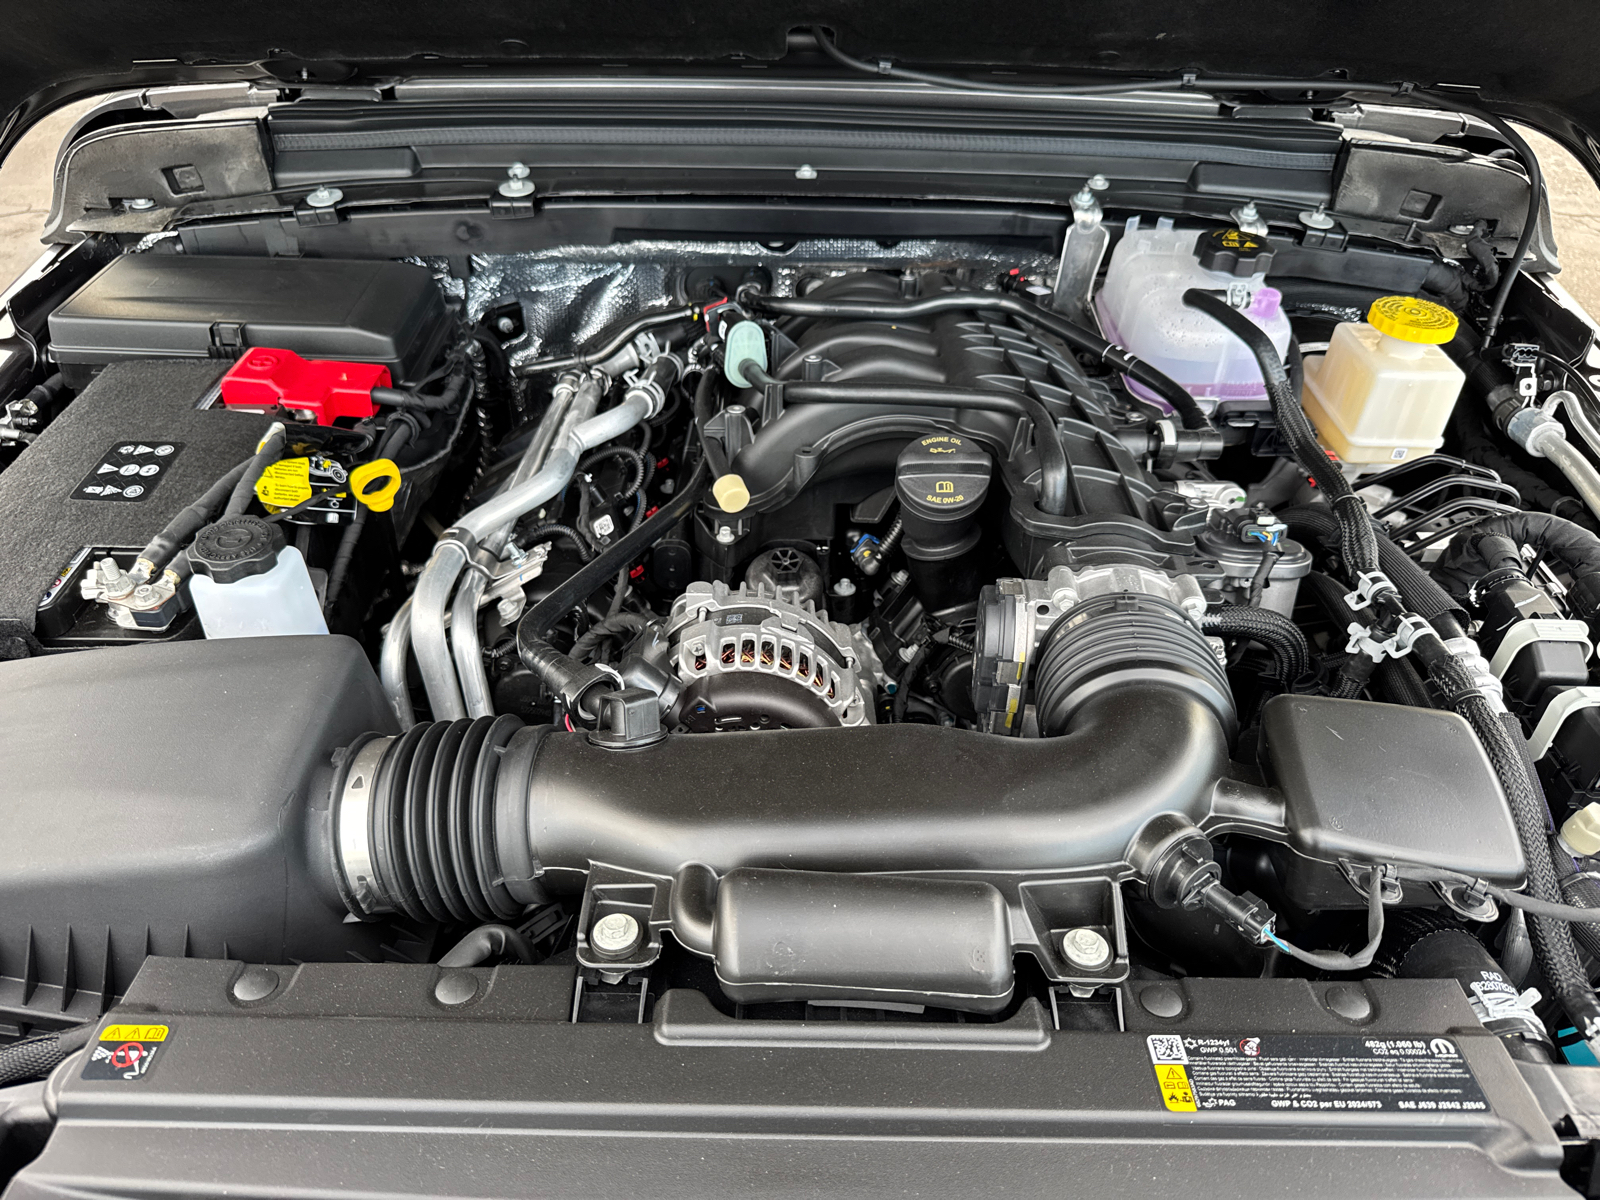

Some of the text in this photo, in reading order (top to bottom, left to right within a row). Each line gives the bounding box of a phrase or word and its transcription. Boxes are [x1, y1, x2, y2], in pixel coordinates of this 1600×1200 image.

[921, 436, 962, 446] ENGINE OIL
[926, 495, 964, 503] SAE 0W-20
[1480, 971, 1502, 981] RAD
